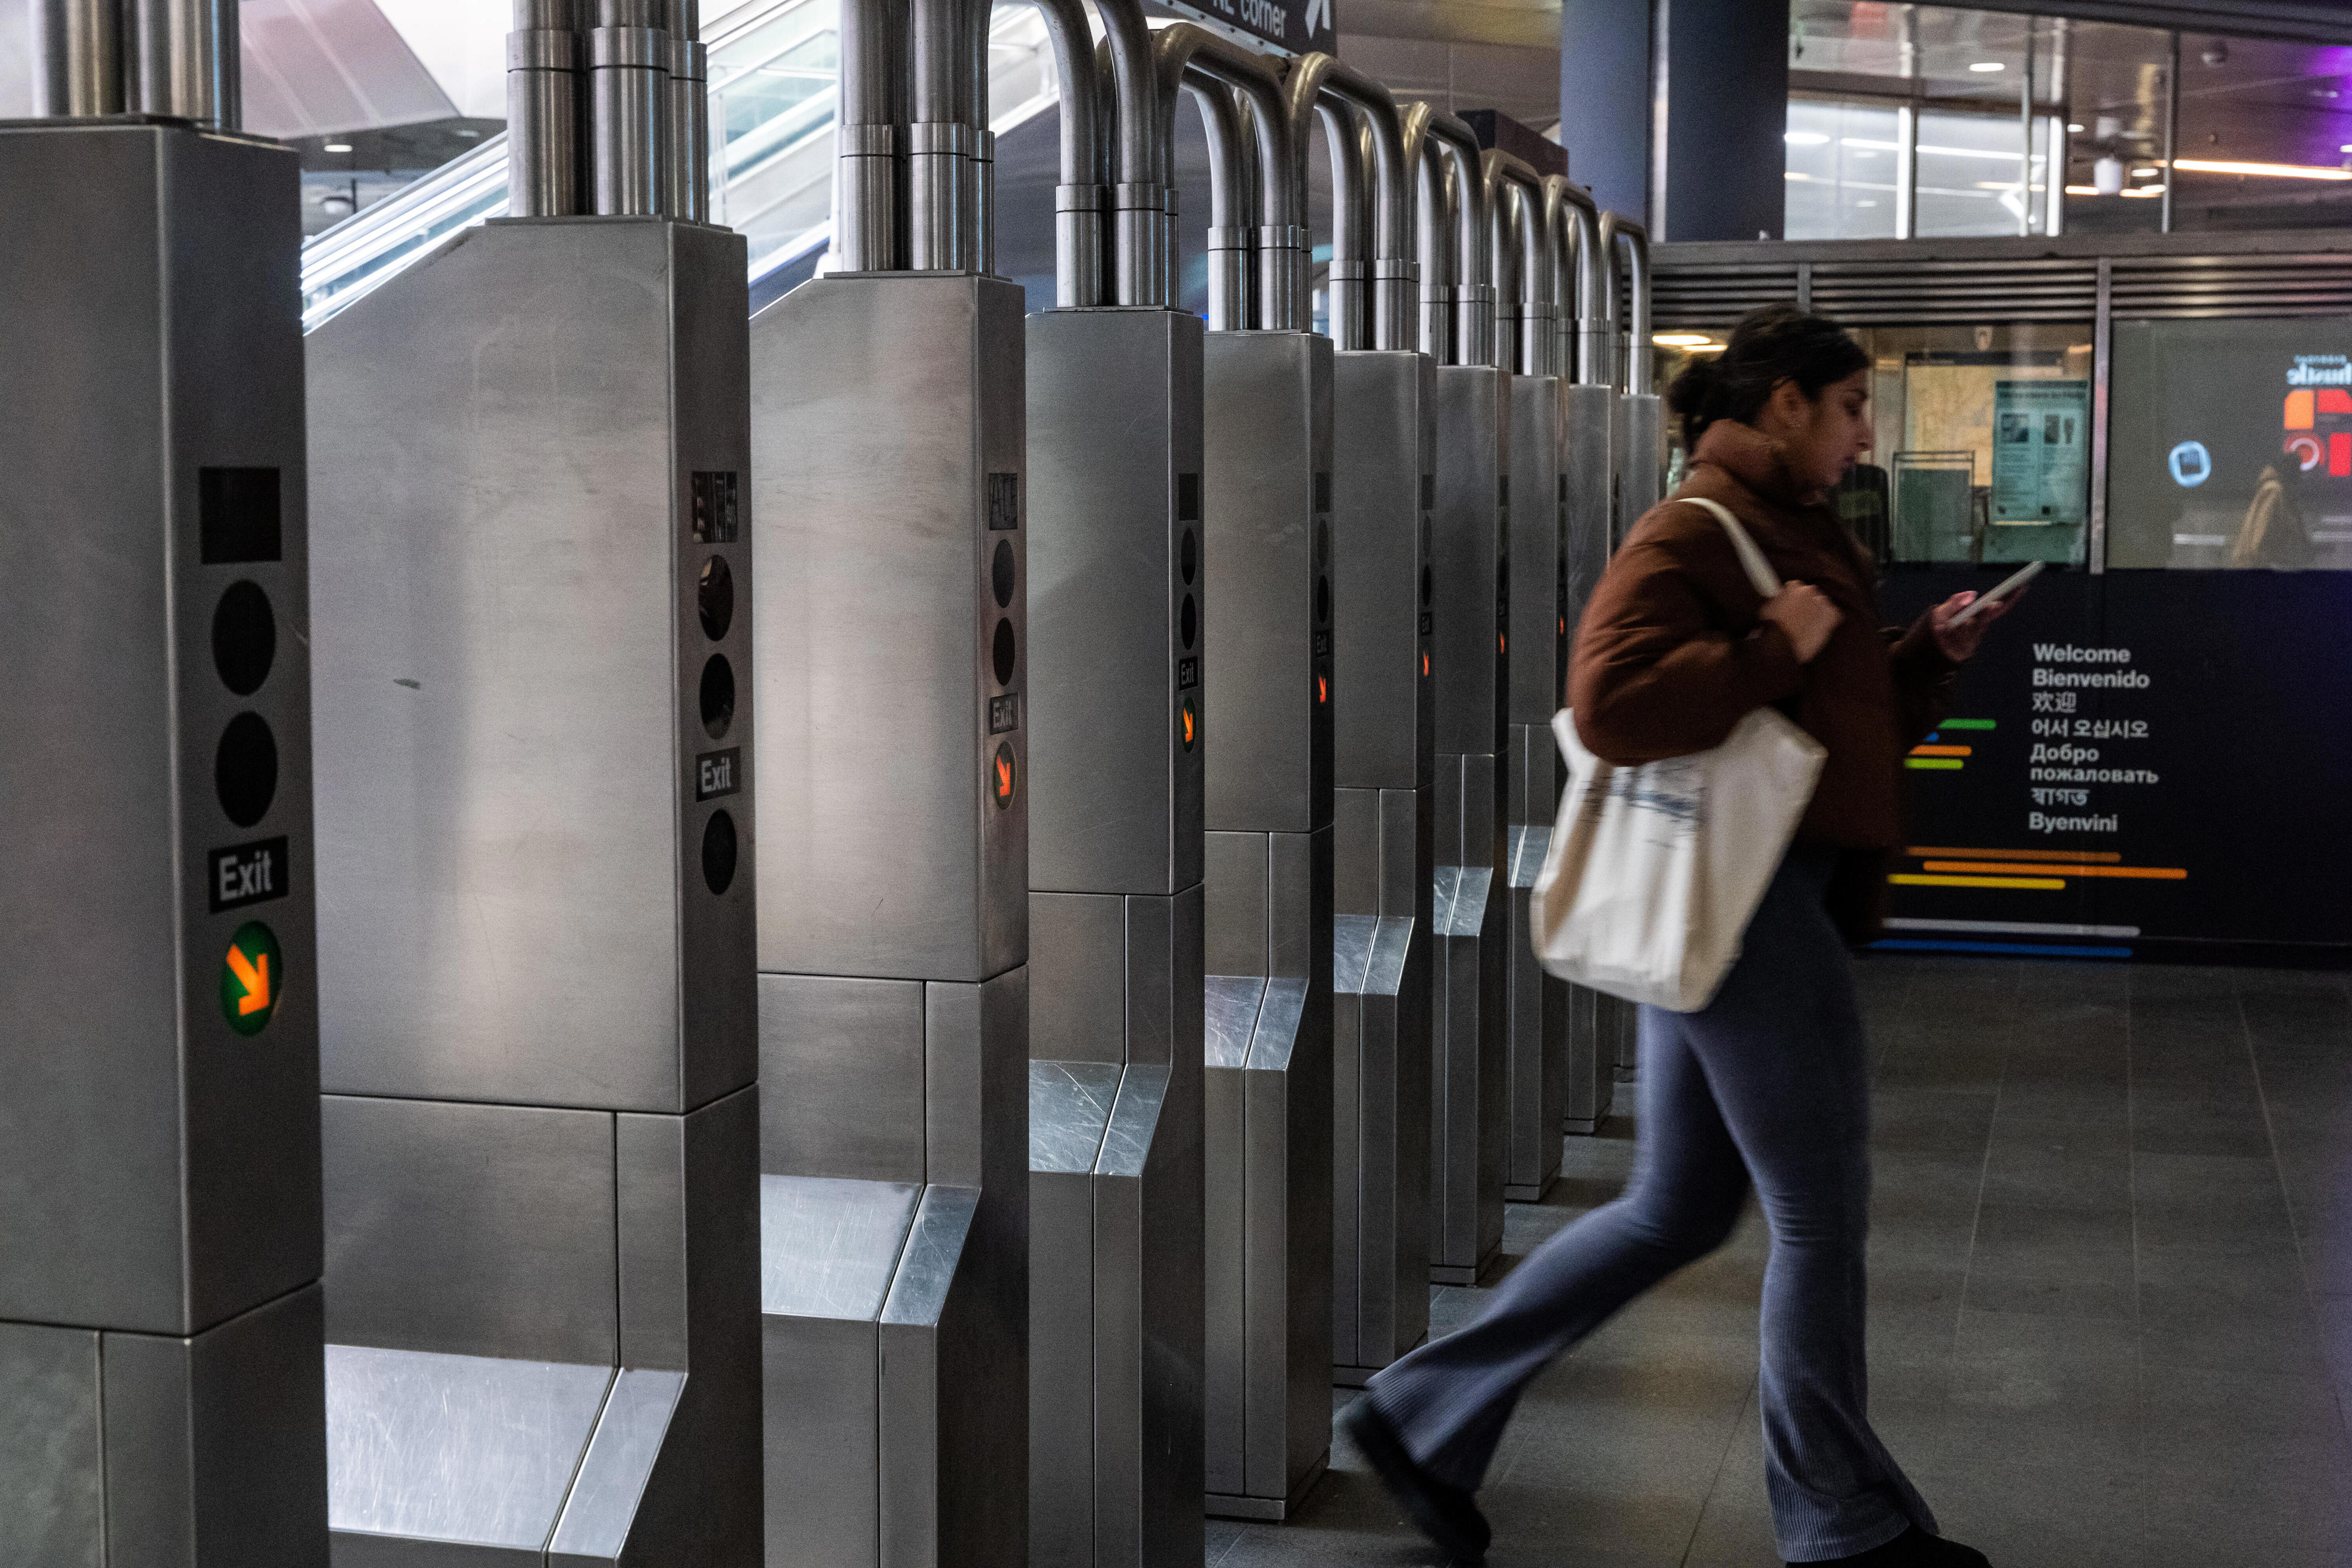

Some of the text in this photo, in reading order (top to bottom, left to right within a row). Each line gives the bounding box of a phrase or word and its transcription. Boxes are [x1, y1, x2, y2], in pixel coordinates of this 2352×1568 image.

[1241, 0, 1286, 39] corner
[2032, 643, 2131, 663] Welcome
[1180, 662, 1194, 686] Exit
[2032, 668, 2151, 689] Bienvenido
[2032, 691, 2077, 713] 欢迎
[993, 700, 1012, 729] Exit
[2031, 718, 2149, 739] 어서 오십시오
[2029, 743, 2100, 766] Добро
[701, 757, 732, 794] Exit
[2029, 767, 2159, 784] пожаловать
[2029, 811, 2118, 834] Byenvini
[218, 850, 273, 902] Exit
